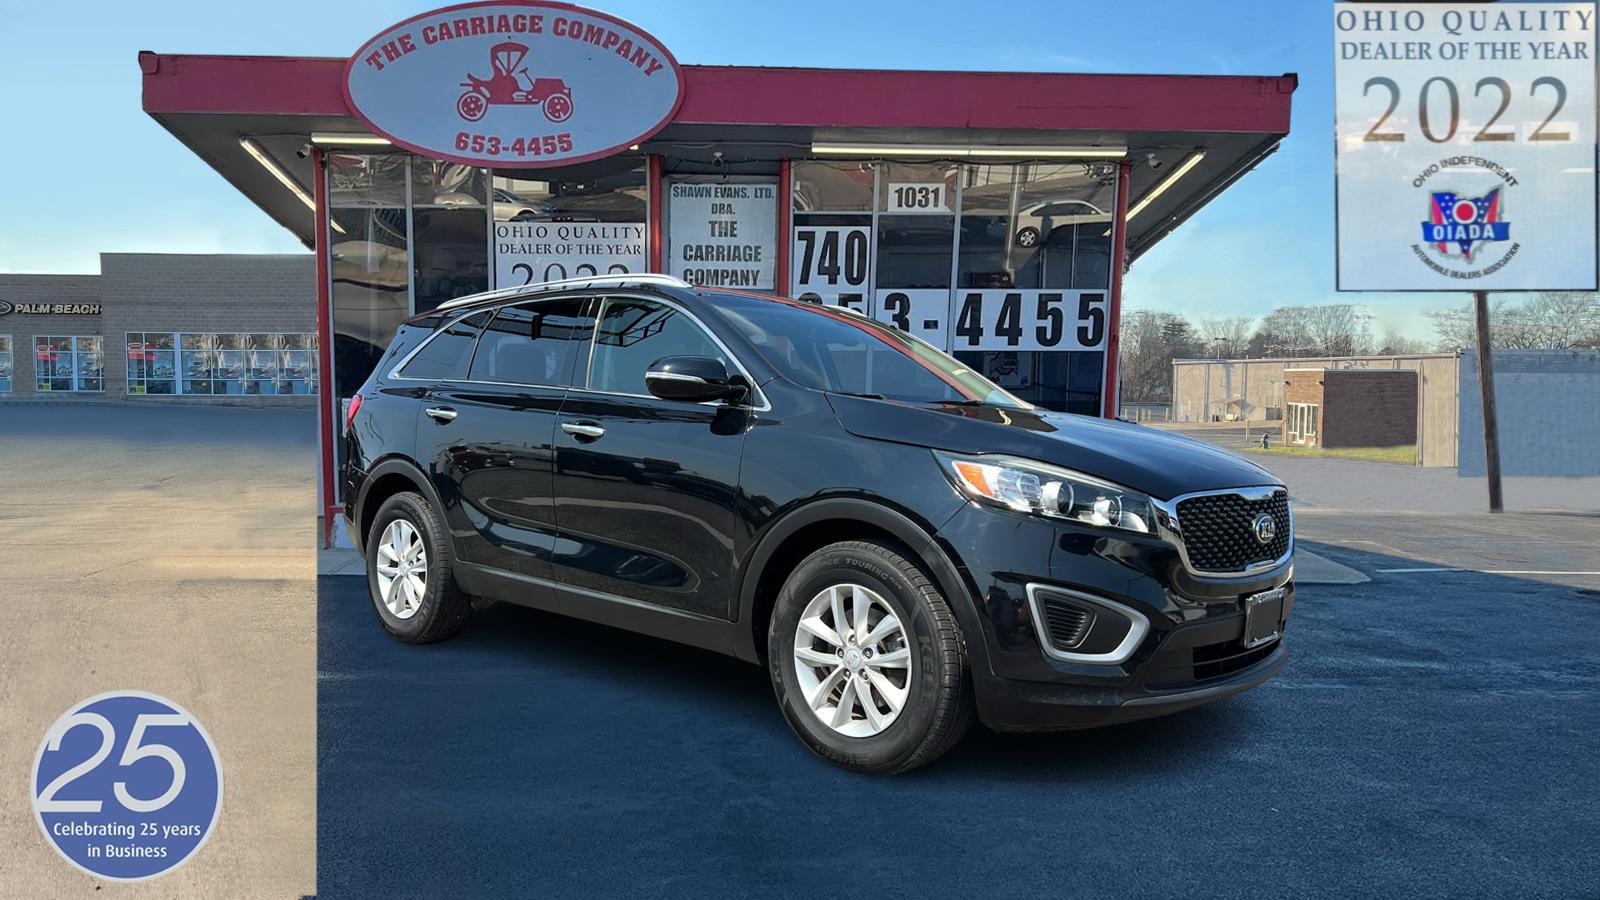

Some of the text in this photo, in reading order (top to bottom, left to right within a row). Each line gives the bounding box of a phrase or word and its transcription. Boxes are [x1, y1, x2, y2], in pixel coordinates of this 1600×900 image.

[1336, 10, 1593, 35] OHIO QUALITY
[365, 14, 664, 78] THE CARRIAGE COMPANY
[1340, 42, 1589, 60] DEALER OF THE YEAR
[1362, 76, 1571, 144] 2022
[455, 131, 573, 156] 653-4455
[1413, 156, 1519, 188] OHIO INDEPENDENT
[672, 186, 712, 198] SHAWN
[754, 187, 775, 199] LTD.
[894, 187, 940, 208] 1031
[711, 203, 736, 215] DBA.
[497, 226, 644, 240] OHIO QUALITY
[708, 221, 738, 237] THE
[1433, 224, 1494, 240] OIADA
[499, 244, 641, 255] DEALER OF THE YEAR
[683, 245, 762, 262] CARRIAGE
[797, 230, 868, 286] 740
[1411, 242, 1521, 280] AUTOMOBILE DEALERS ASSOCIATION
[683, 269, 760, 286] COMPANY
[15, 304, 100, 314] PALM BEACH
[845, 558, 889, 580] TOURING
